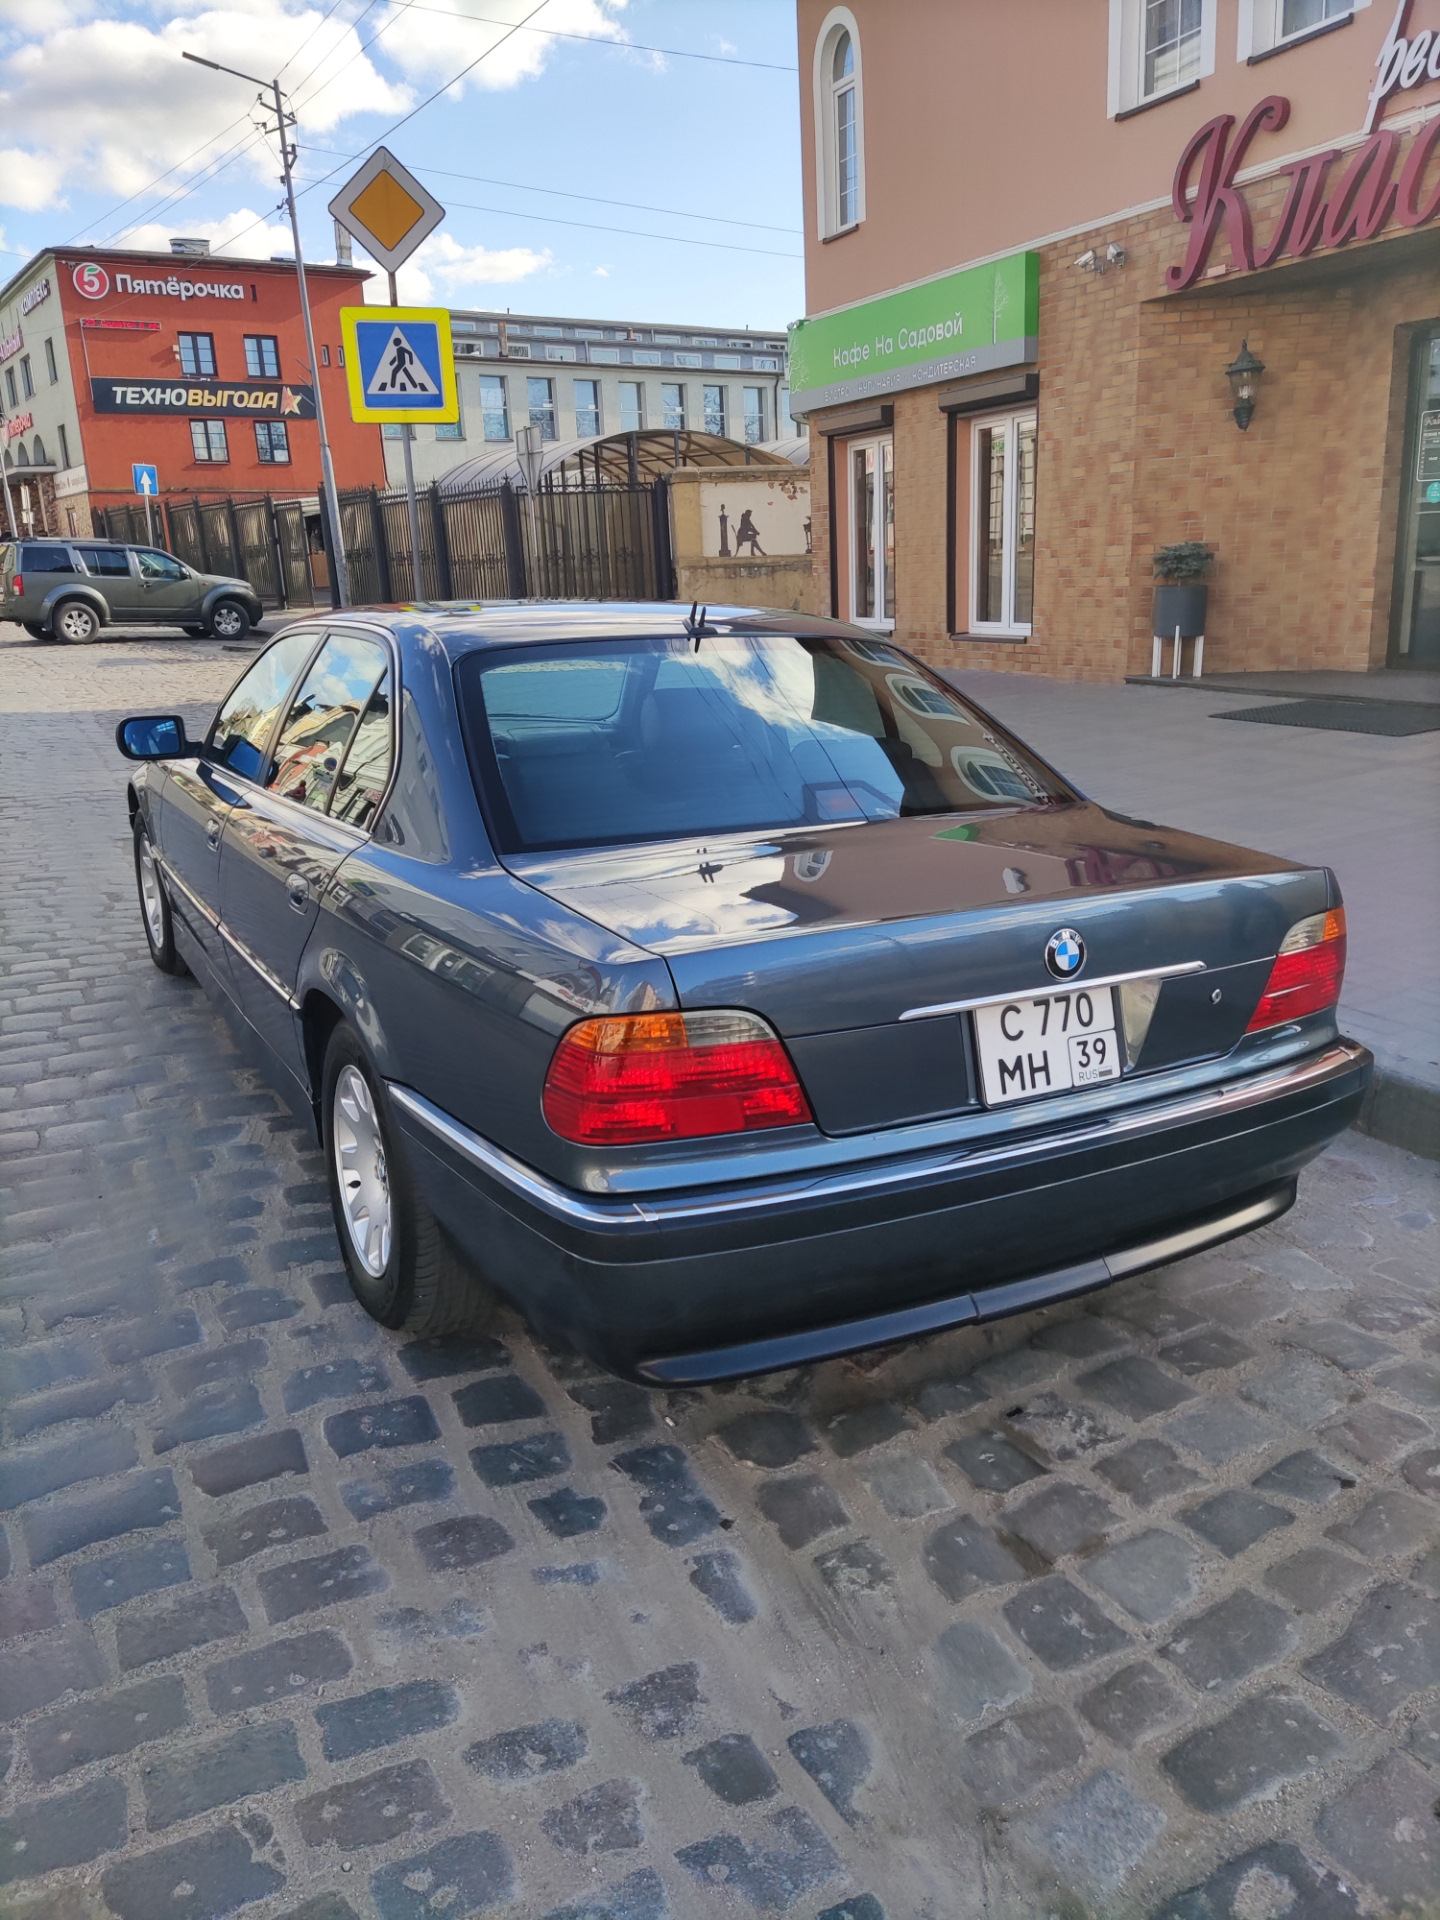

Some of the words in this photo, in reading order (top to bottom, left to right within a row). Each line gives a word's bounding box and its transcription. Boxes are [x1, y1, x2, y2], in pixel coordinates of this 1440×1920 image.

[115, 273, 245, 301] Пятёрочка
[832, 339, 871, 369] Кафе
[875, 333, 894, 356] На
[897, 311, 964, 350] Садовой
[911, 355, 977, 382] КОНДИТЕРСКАЯ
[112, 386, 279, 409] ТЕХНОВЫГОДА
[1033, 992, 1094, 1036] 770
[1076, 1037, 1106, 1068] 39
[1078, 1068, 1098, 1082] RUS
